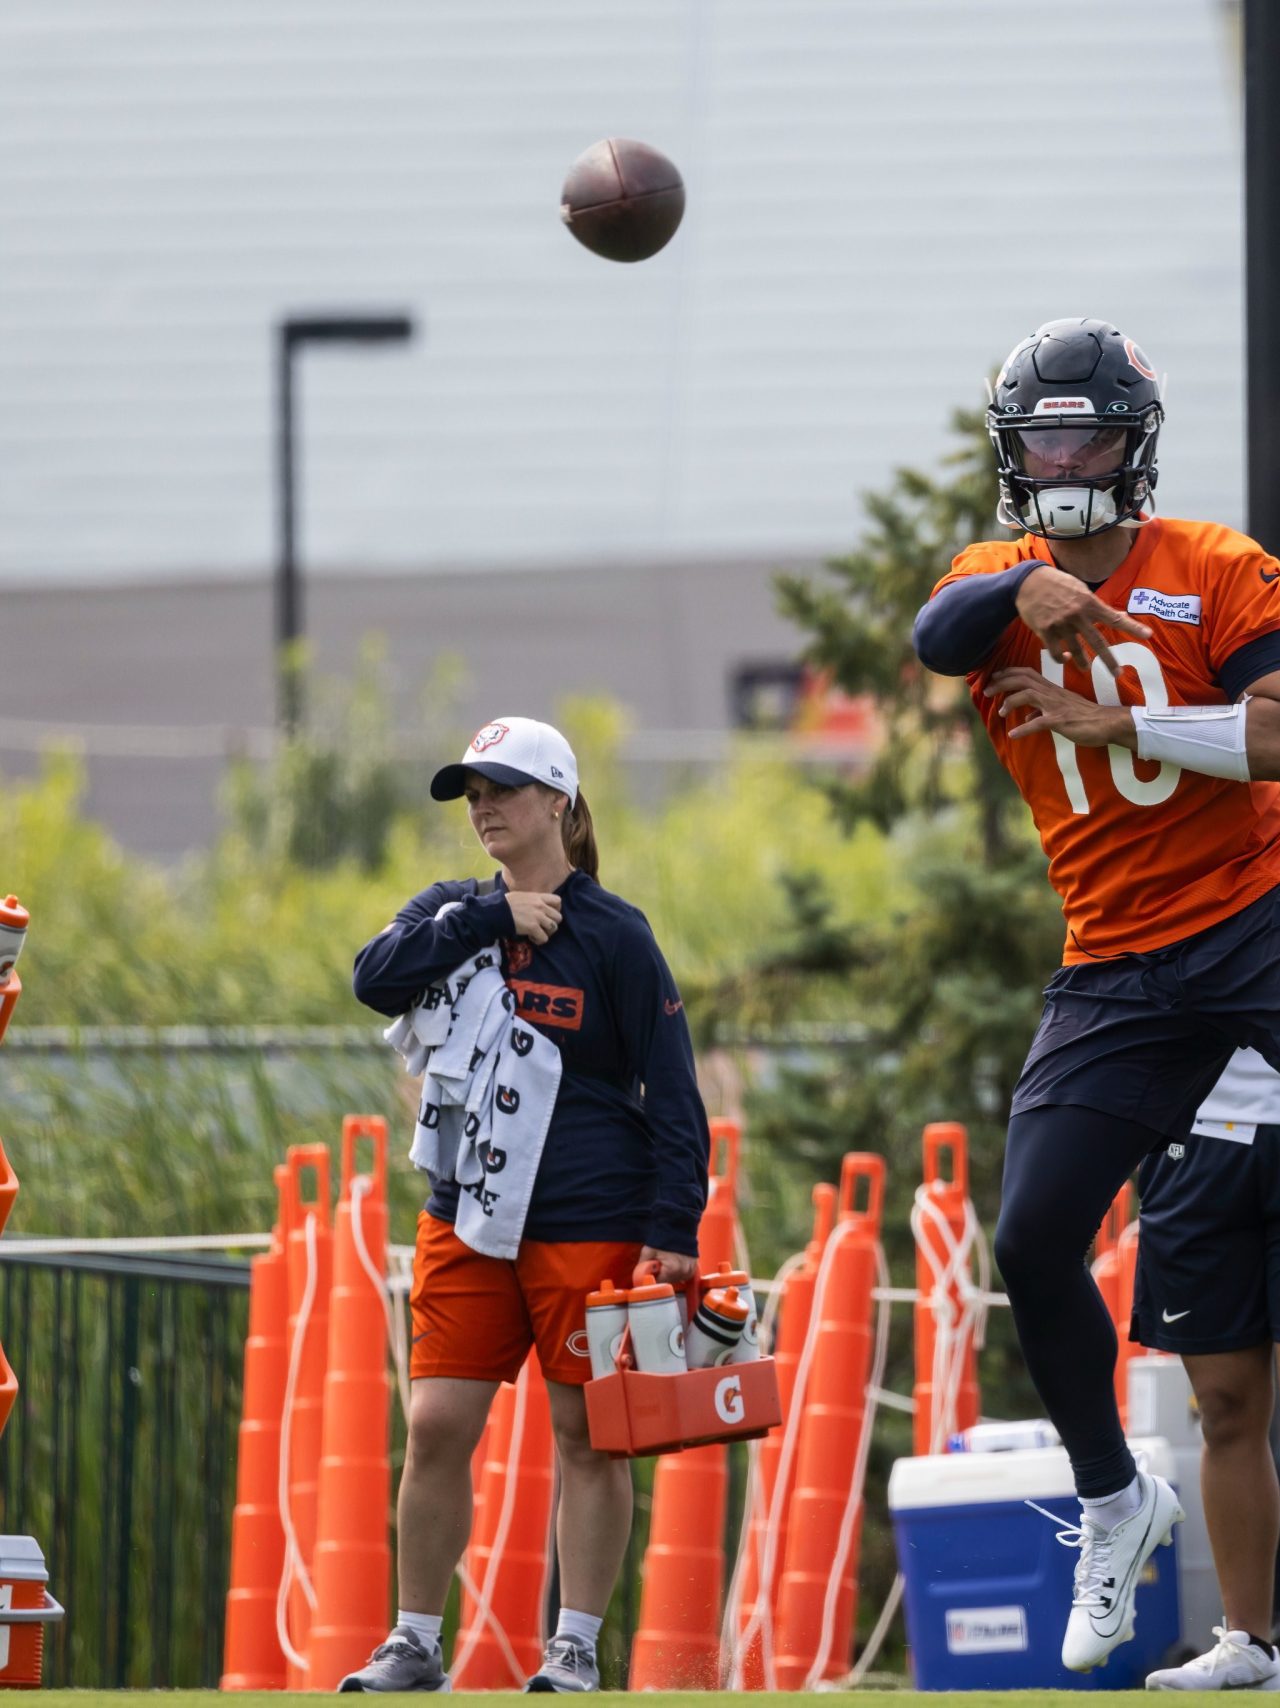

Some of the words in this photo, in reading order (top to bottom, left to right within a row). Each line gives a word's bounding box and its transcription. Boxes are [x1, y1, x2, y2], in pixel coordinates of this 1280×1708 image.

[1043, 401, 1085, 409] BEARS
[1150, 596, 1190, 609] Advocate
[1148, 603, 1176, 618] Health
[1177, 609, 1199, 621] Care
[1041, 642, 1182, 815] 10
[715, 1375, 745, 1424] G
